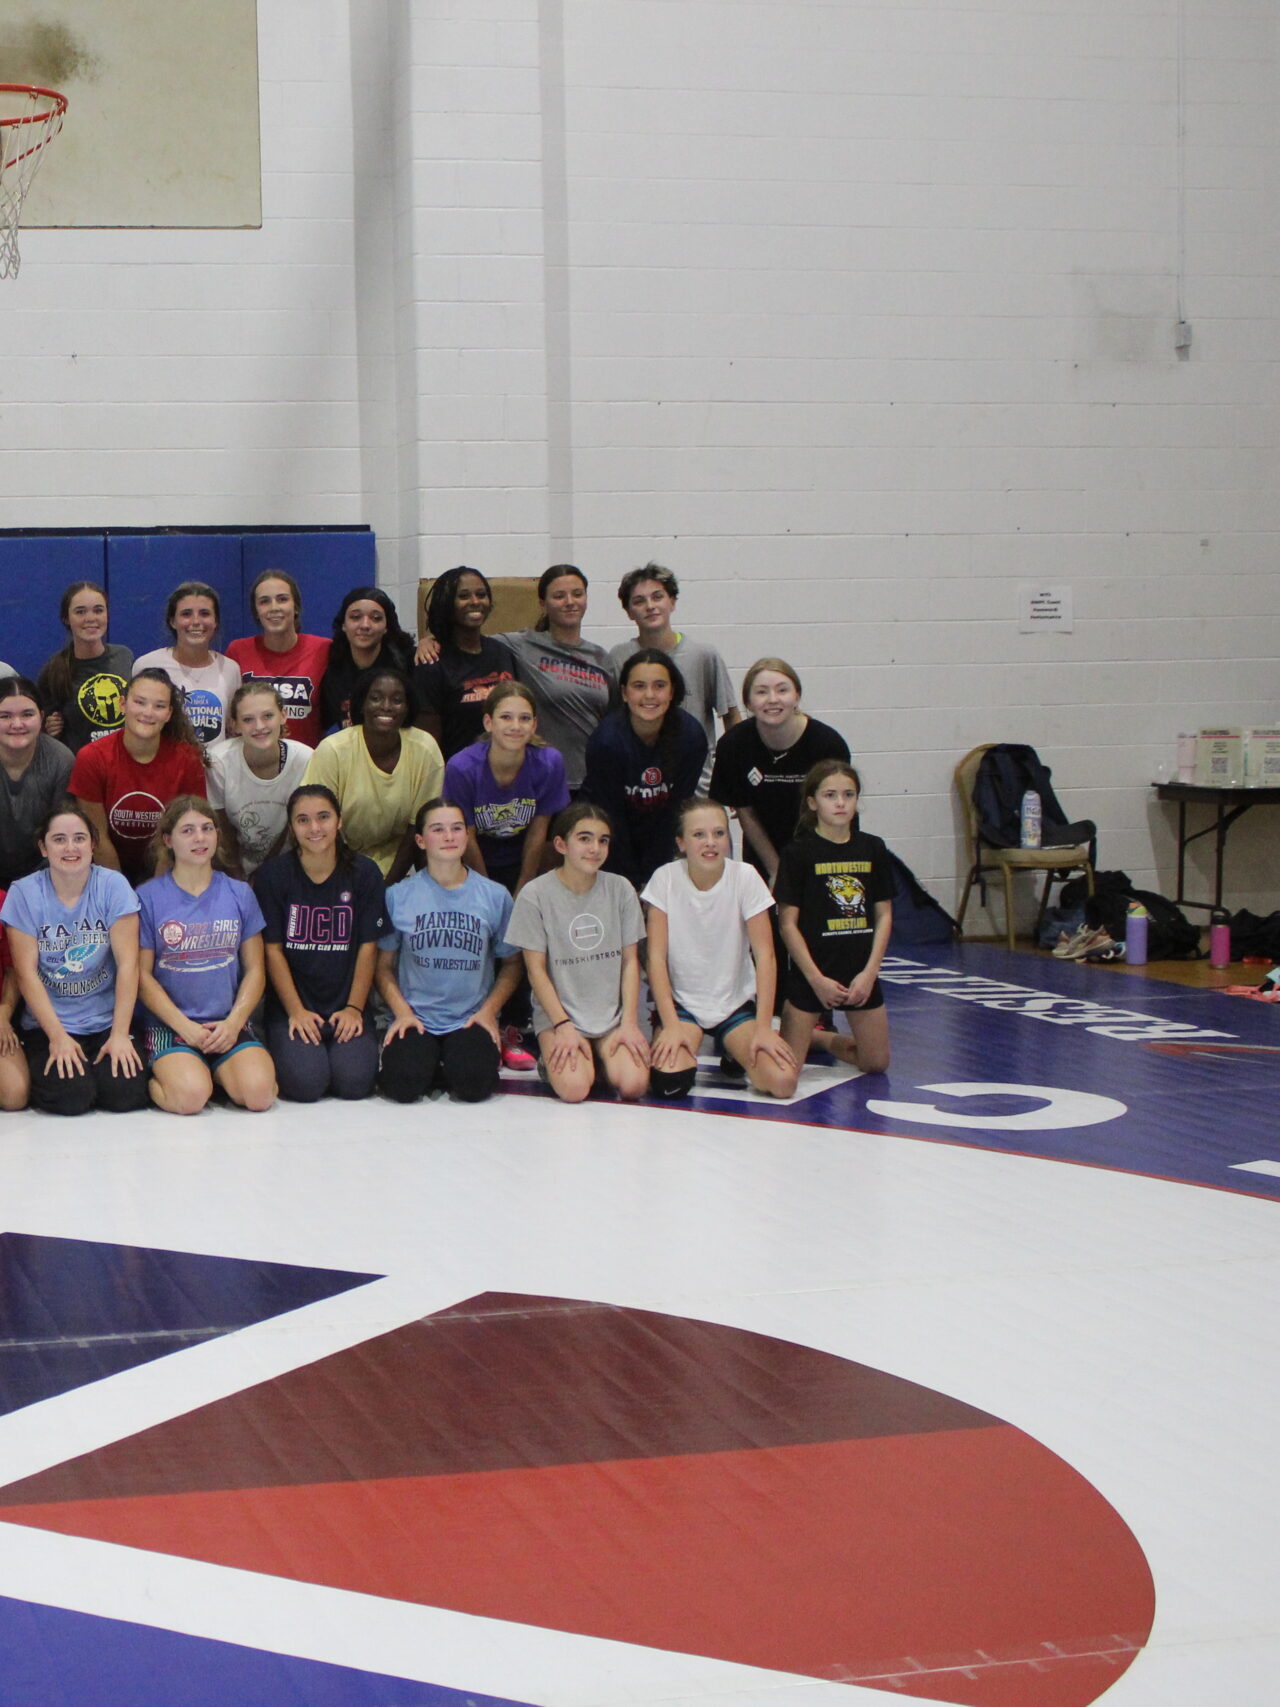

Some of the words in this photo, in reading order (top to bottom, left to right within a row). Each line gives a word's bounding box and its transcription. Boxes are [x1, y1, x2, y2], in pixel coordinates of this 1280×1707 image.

[192, 716, 218, 729] UALS
[113, 809, 134, 819] SOUTH
[213, 919, 239, 932] GIRLS
[286, 904, 353, 943] UCD
[414, 911, 481, 935] MANHEIM
[181, 933, 238, 951] WRESTLING
[285, 942, 316, 951] ULTIMATE
[410, 928, 483, 957] TOWNSHIP
